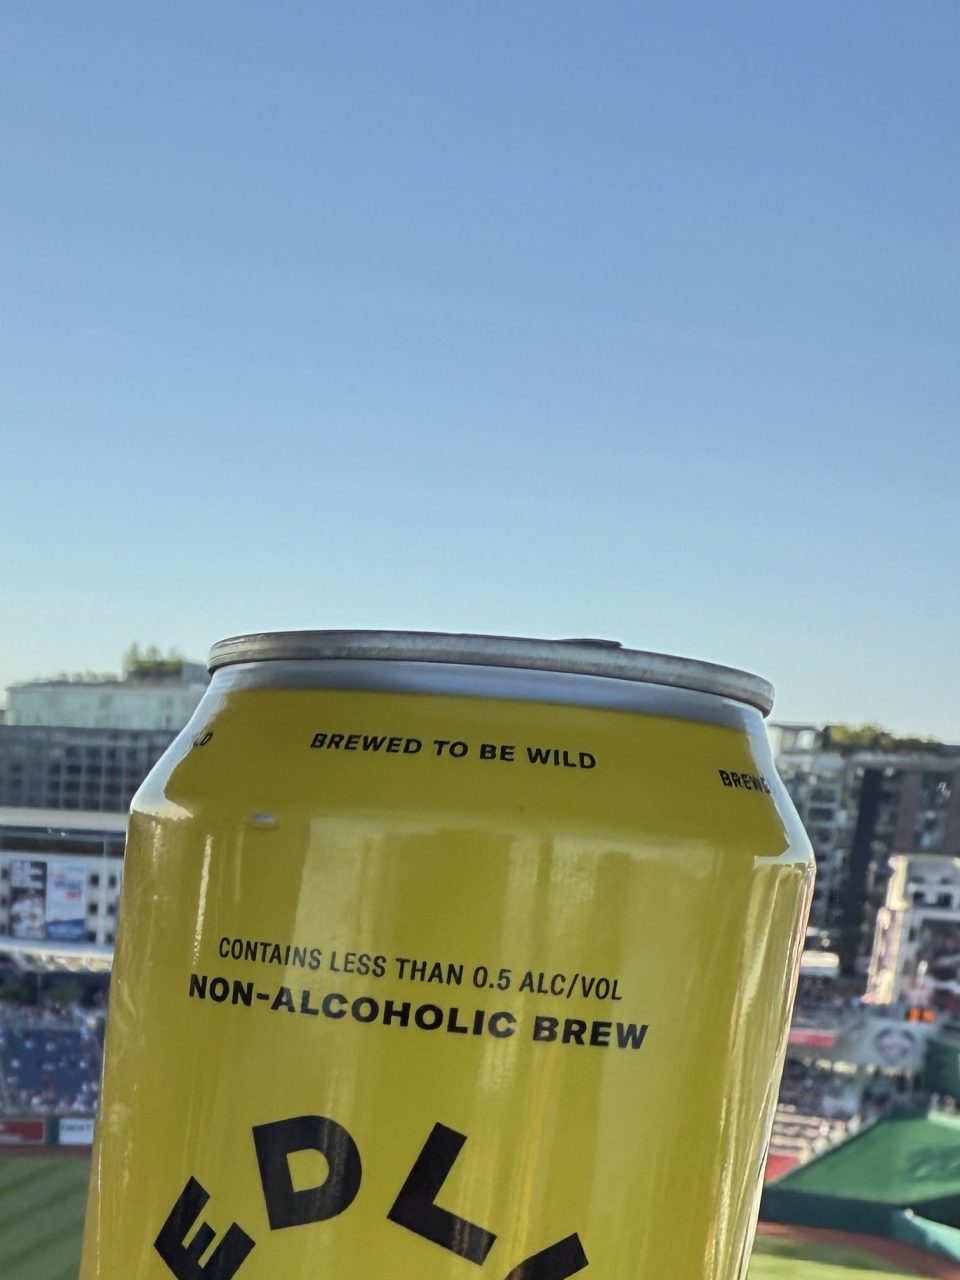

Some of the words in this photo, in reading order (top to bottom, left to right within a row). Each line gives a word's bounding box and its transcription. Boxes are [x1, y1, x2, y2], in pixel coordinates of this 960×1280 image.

[310, 733, 422, 754] BREWED
[433, 739, 468, 758] TO
[480, 743, 516, 762] BE
[527, 746, 596, 769] WILD
[219, 936, 322, 970] CONTAINS
[330, 950, 386, 977] LESS
[396, 957, 464, 985] THAN
[473, 966, 512, 991] 0.5
[519, 971, 623, 1000] ALC/VOL
[189, 973, 517, 1038] NON-ALCOHOLIC
[533, 1015, 649, 1050] BREW
